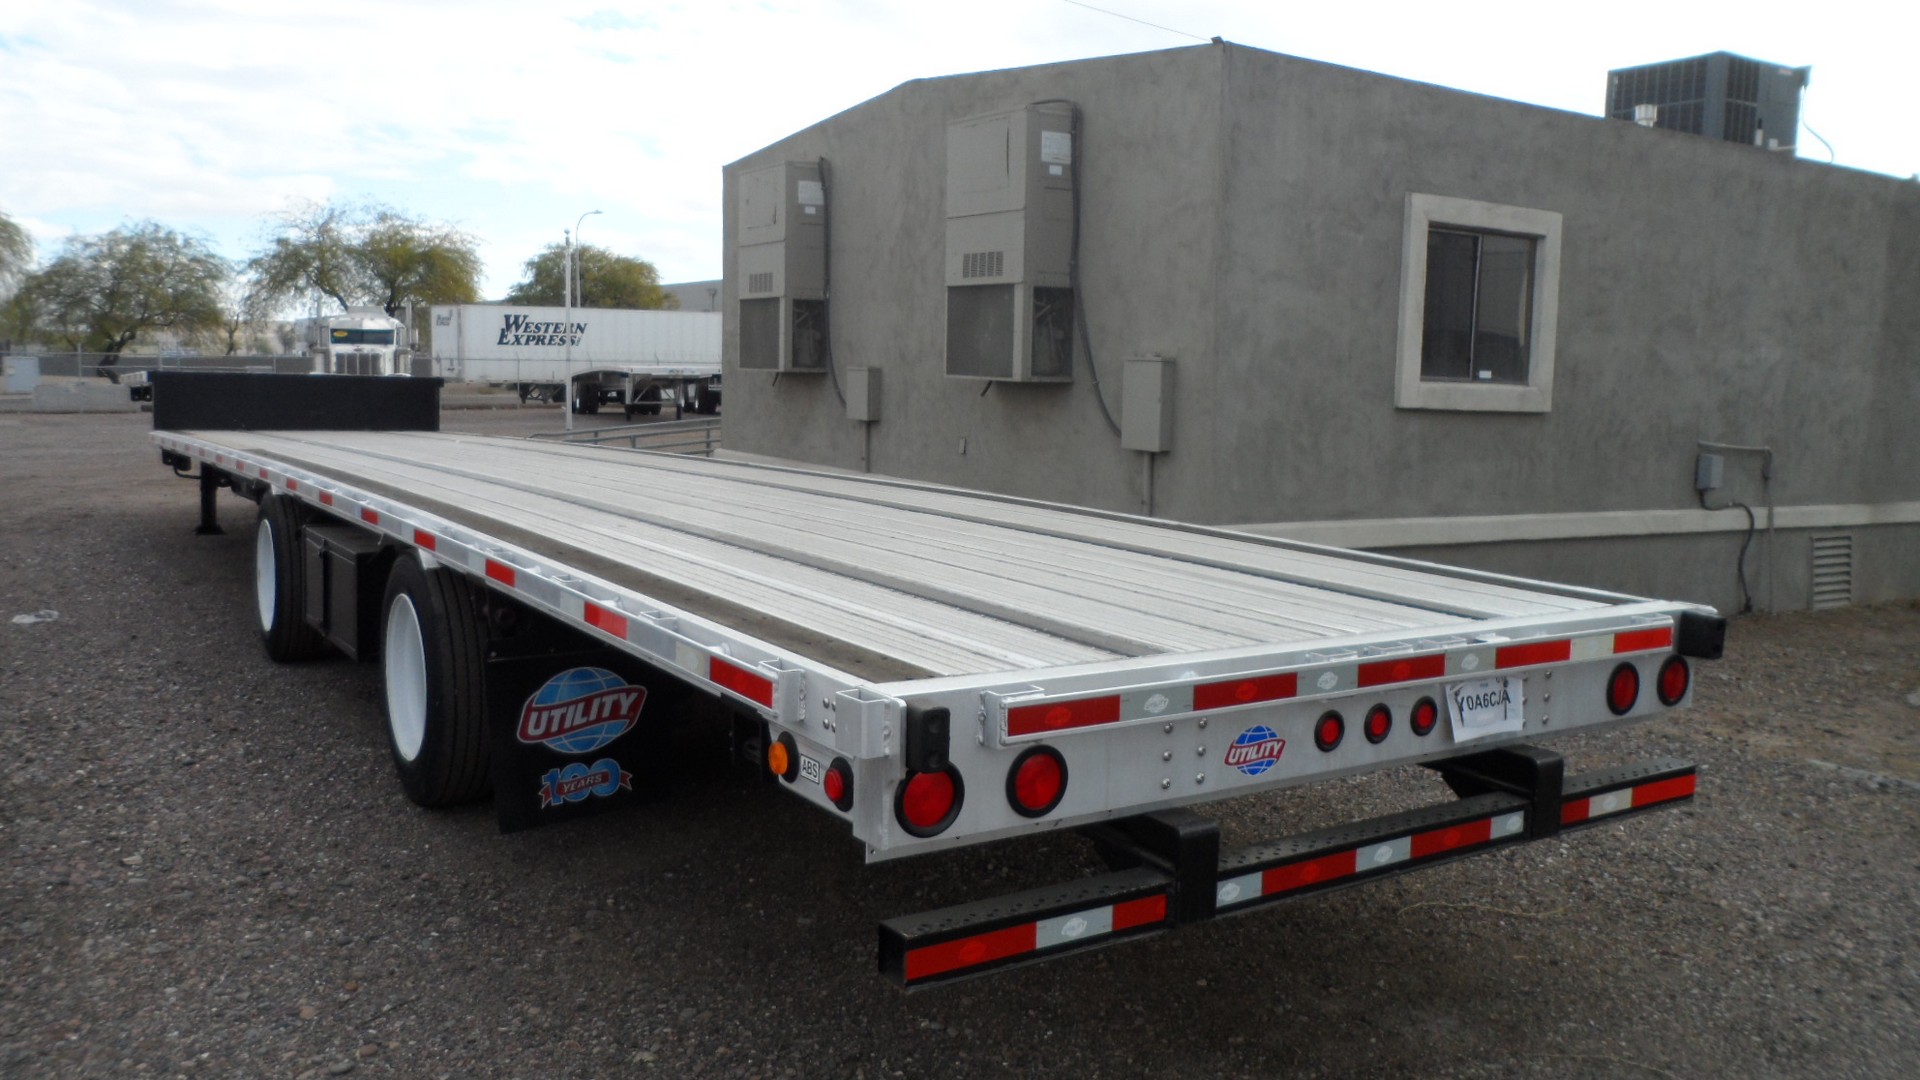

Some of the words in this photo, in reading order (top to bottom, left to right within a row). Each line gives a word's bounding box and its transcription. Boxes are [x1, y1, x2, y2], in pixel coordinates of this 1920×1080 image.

[504, 314, 587, 334] WESTERN
[527, 692, 639, 737] UTILITY
[1228, 741, 1282, 764] UTILITY
[801, 758, 818, 779] ABS
[562, 773, 603, 793] YEARS
